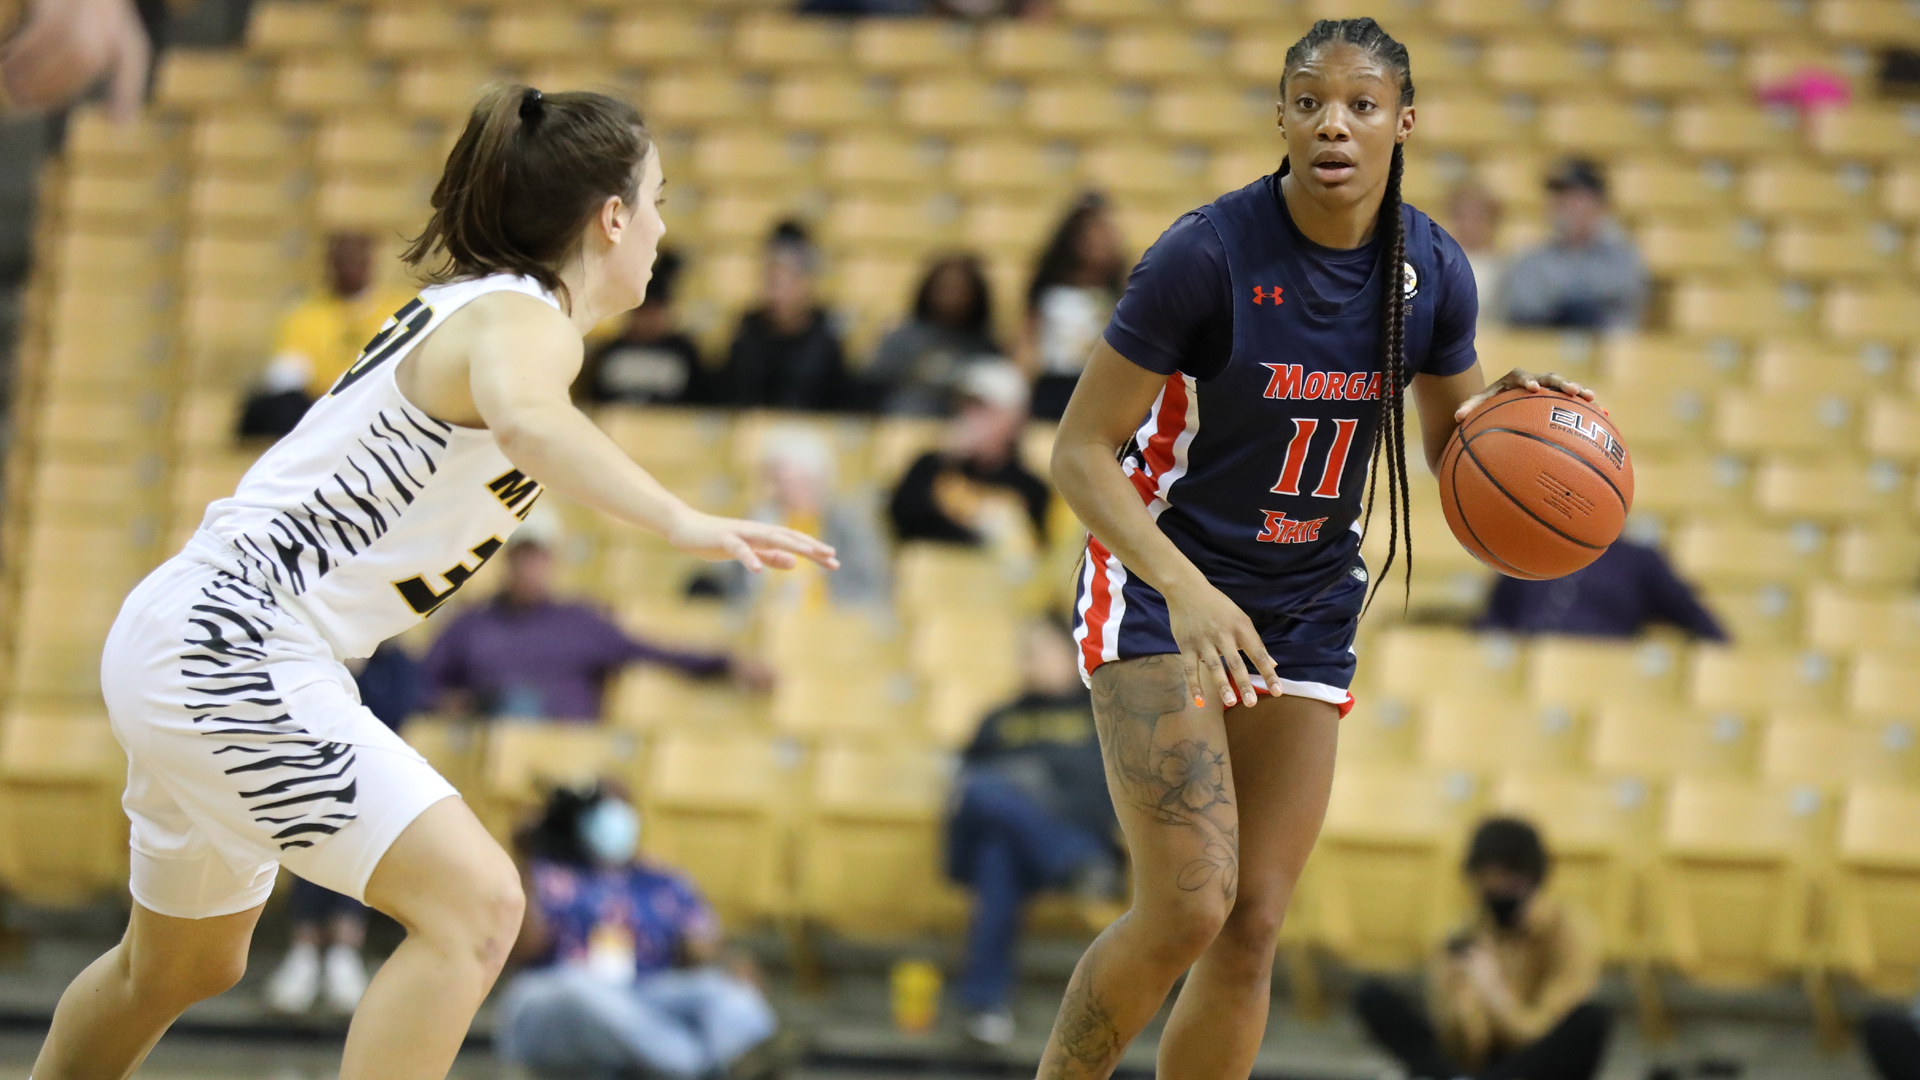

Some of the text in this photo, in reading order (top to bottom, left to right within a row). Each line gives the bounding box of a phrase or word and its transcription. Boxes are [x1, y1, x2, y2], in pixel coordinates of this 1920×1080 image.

[1259, 362, 1395, 401] MORGA
[1269, 418, 1359, 498] 11
[1549, 423, 1622, 471] CHAMPIONSHIP
[1550, 405, 1626, 468] ELITE
[1256, 509, 1330, 543] STATE
